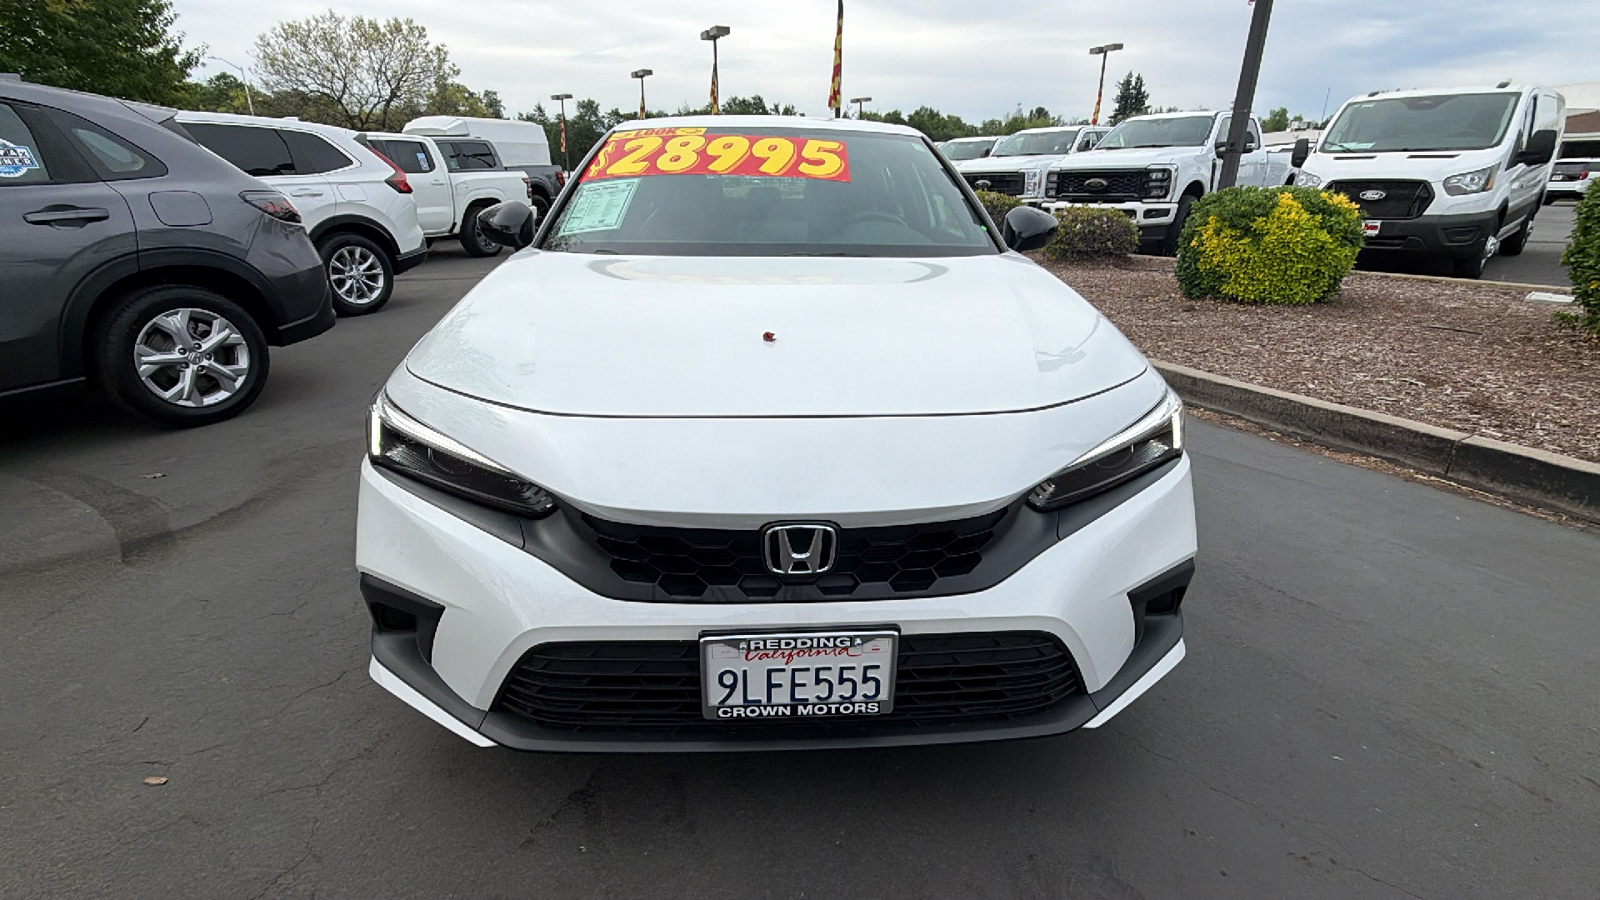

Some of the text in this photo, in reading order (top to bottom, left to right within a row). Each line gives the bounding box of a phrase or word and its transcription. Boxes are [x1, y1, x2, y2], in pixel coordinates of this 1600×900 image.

[633, 127, 678, 137] LOOK
[588, 135, 846, 179] $28995
[749, 637, 851, 650] REDDING
[744, 647, 863, 665] California
[717, 664, 881, 706] 9LFE555
[718, 703, 879, 718] CROWN MOTORS
